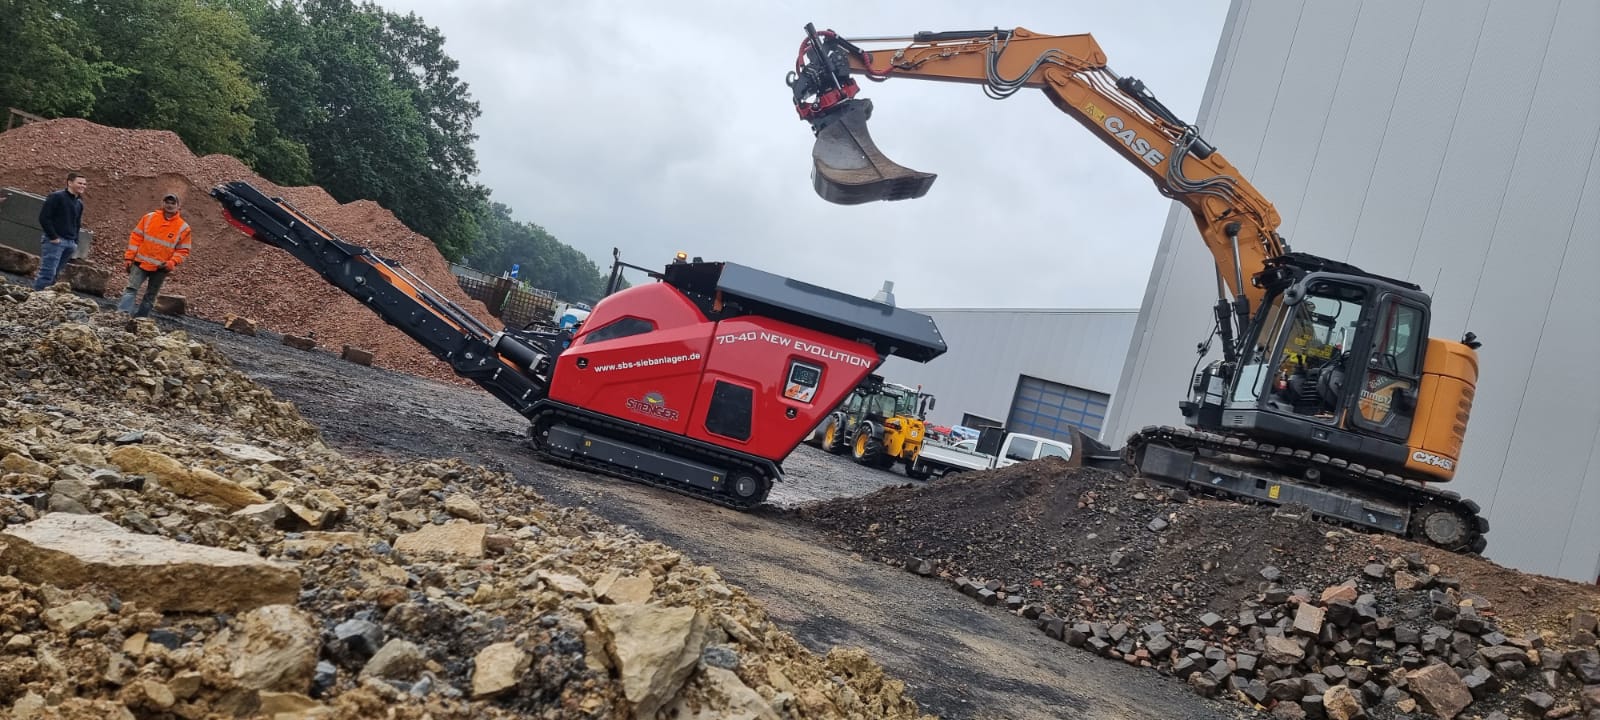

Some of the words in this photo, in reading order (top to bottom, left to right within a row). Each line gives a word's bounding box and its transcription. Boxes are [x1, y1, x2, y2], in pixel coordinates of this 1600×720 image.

[1104, 115, 1167, 167] CASE
[594, 353, 701, 373] www.sbs-siebanlagen.de
[716, 331, 757, 345] 70-40
[759, 331, 791, 347] NEW
[794, 341, 871, 369] EVOLUTION
[626, 398, 679, 420] STENGER
